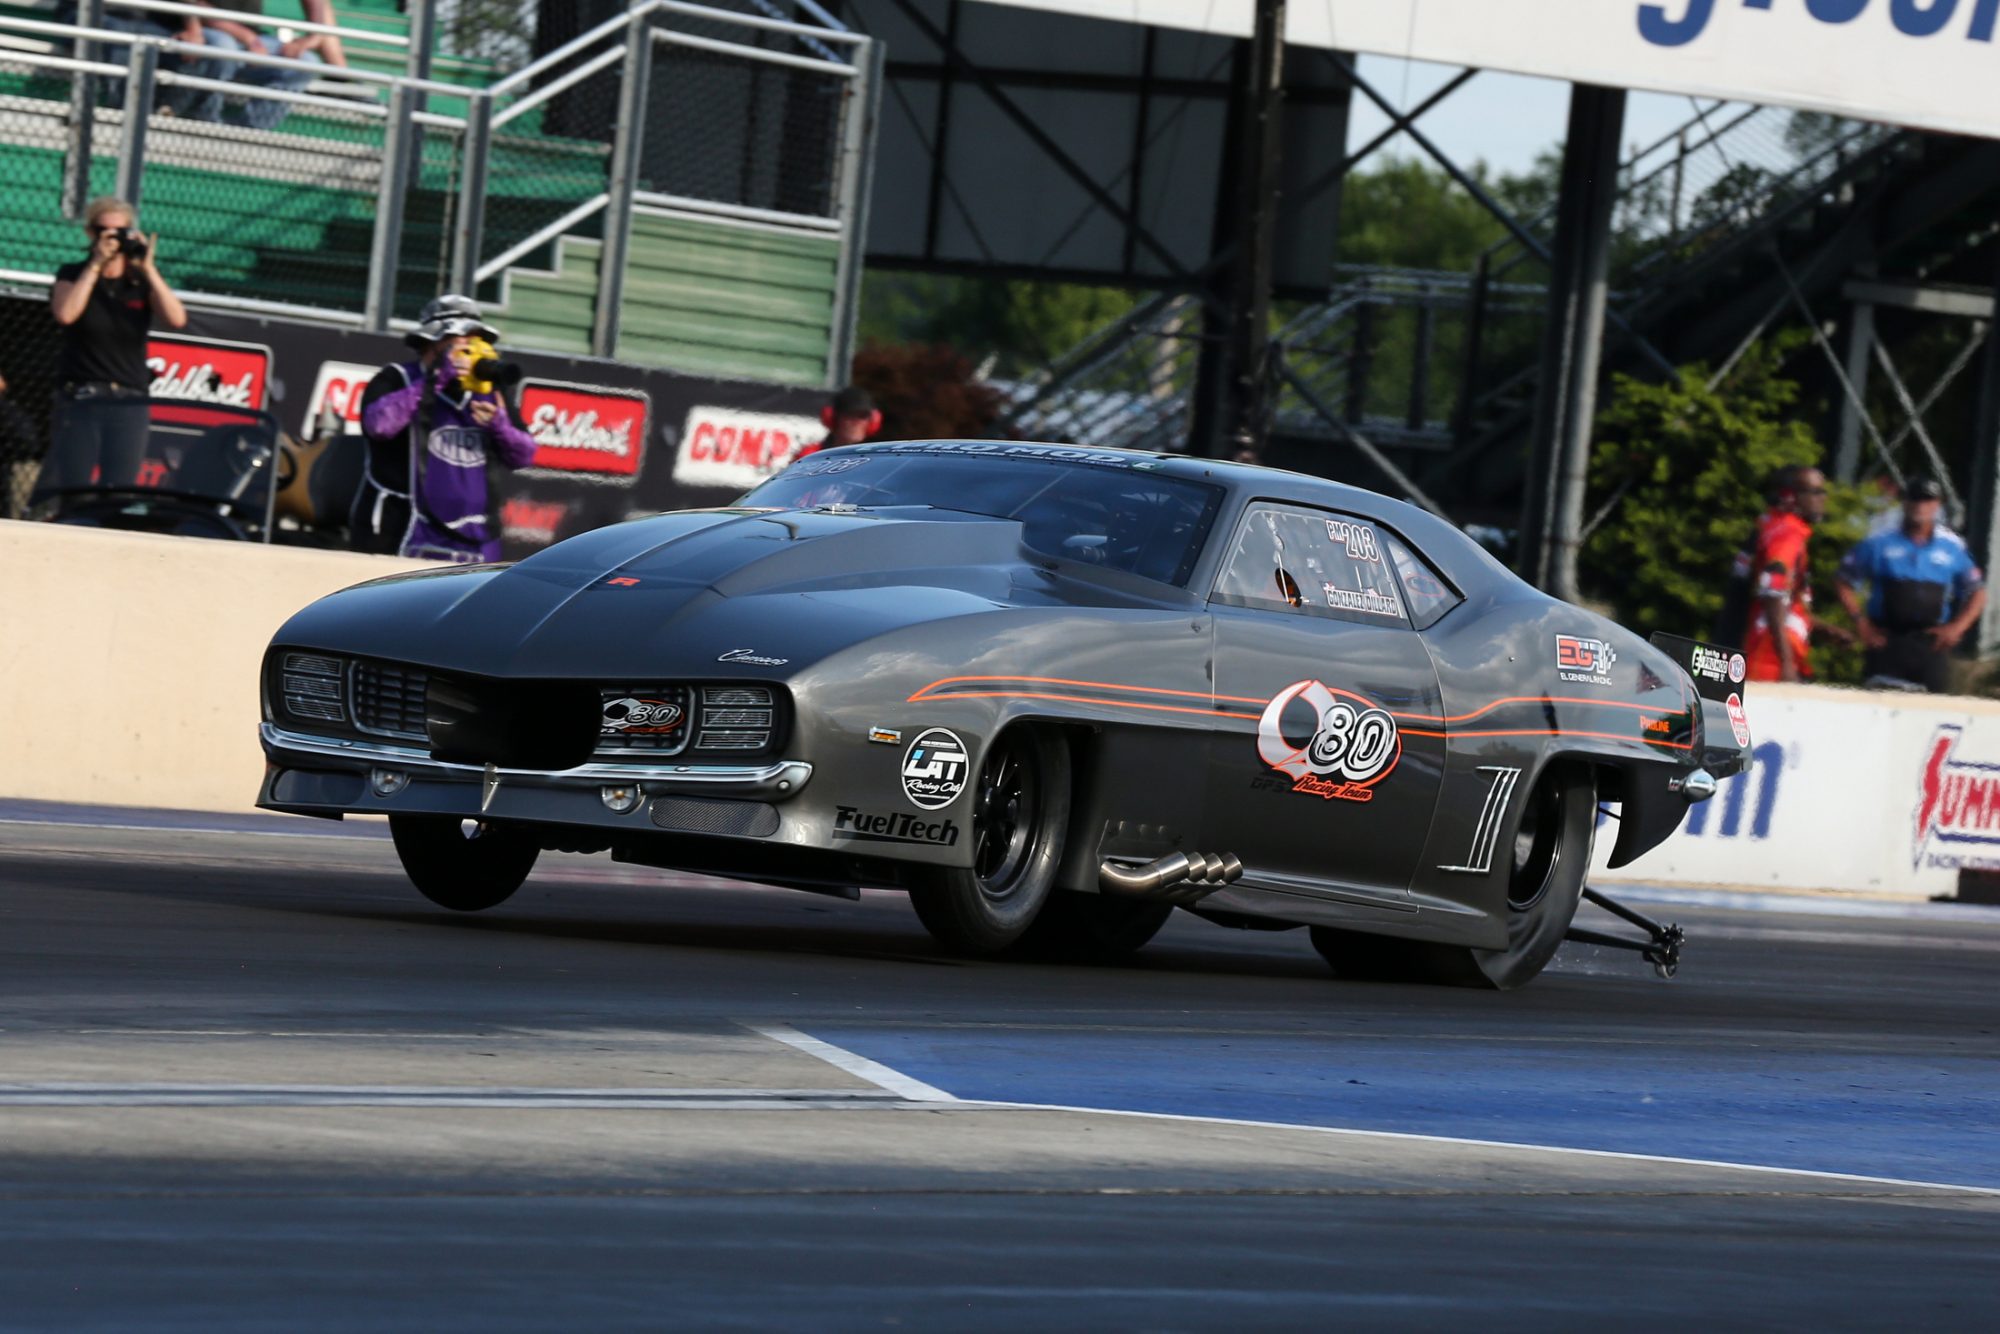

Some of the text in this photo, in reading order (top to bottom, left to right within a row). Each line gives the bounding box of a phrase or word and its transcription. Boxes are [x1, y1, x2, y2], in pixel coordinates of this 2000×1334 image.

[319, 378, 369, 422] CO
[690, 421, 790, 469] COMP
[1004, 447, 1126, 463] MOD
[1326, 520, 1379, 562] PM 203
[904, 749, 966, 780] LAT
[906, 779, 941, 794] Racing
[1298, 774, 1374, 800] Racing Team
[835, 805, 959, 846] FuelTech
